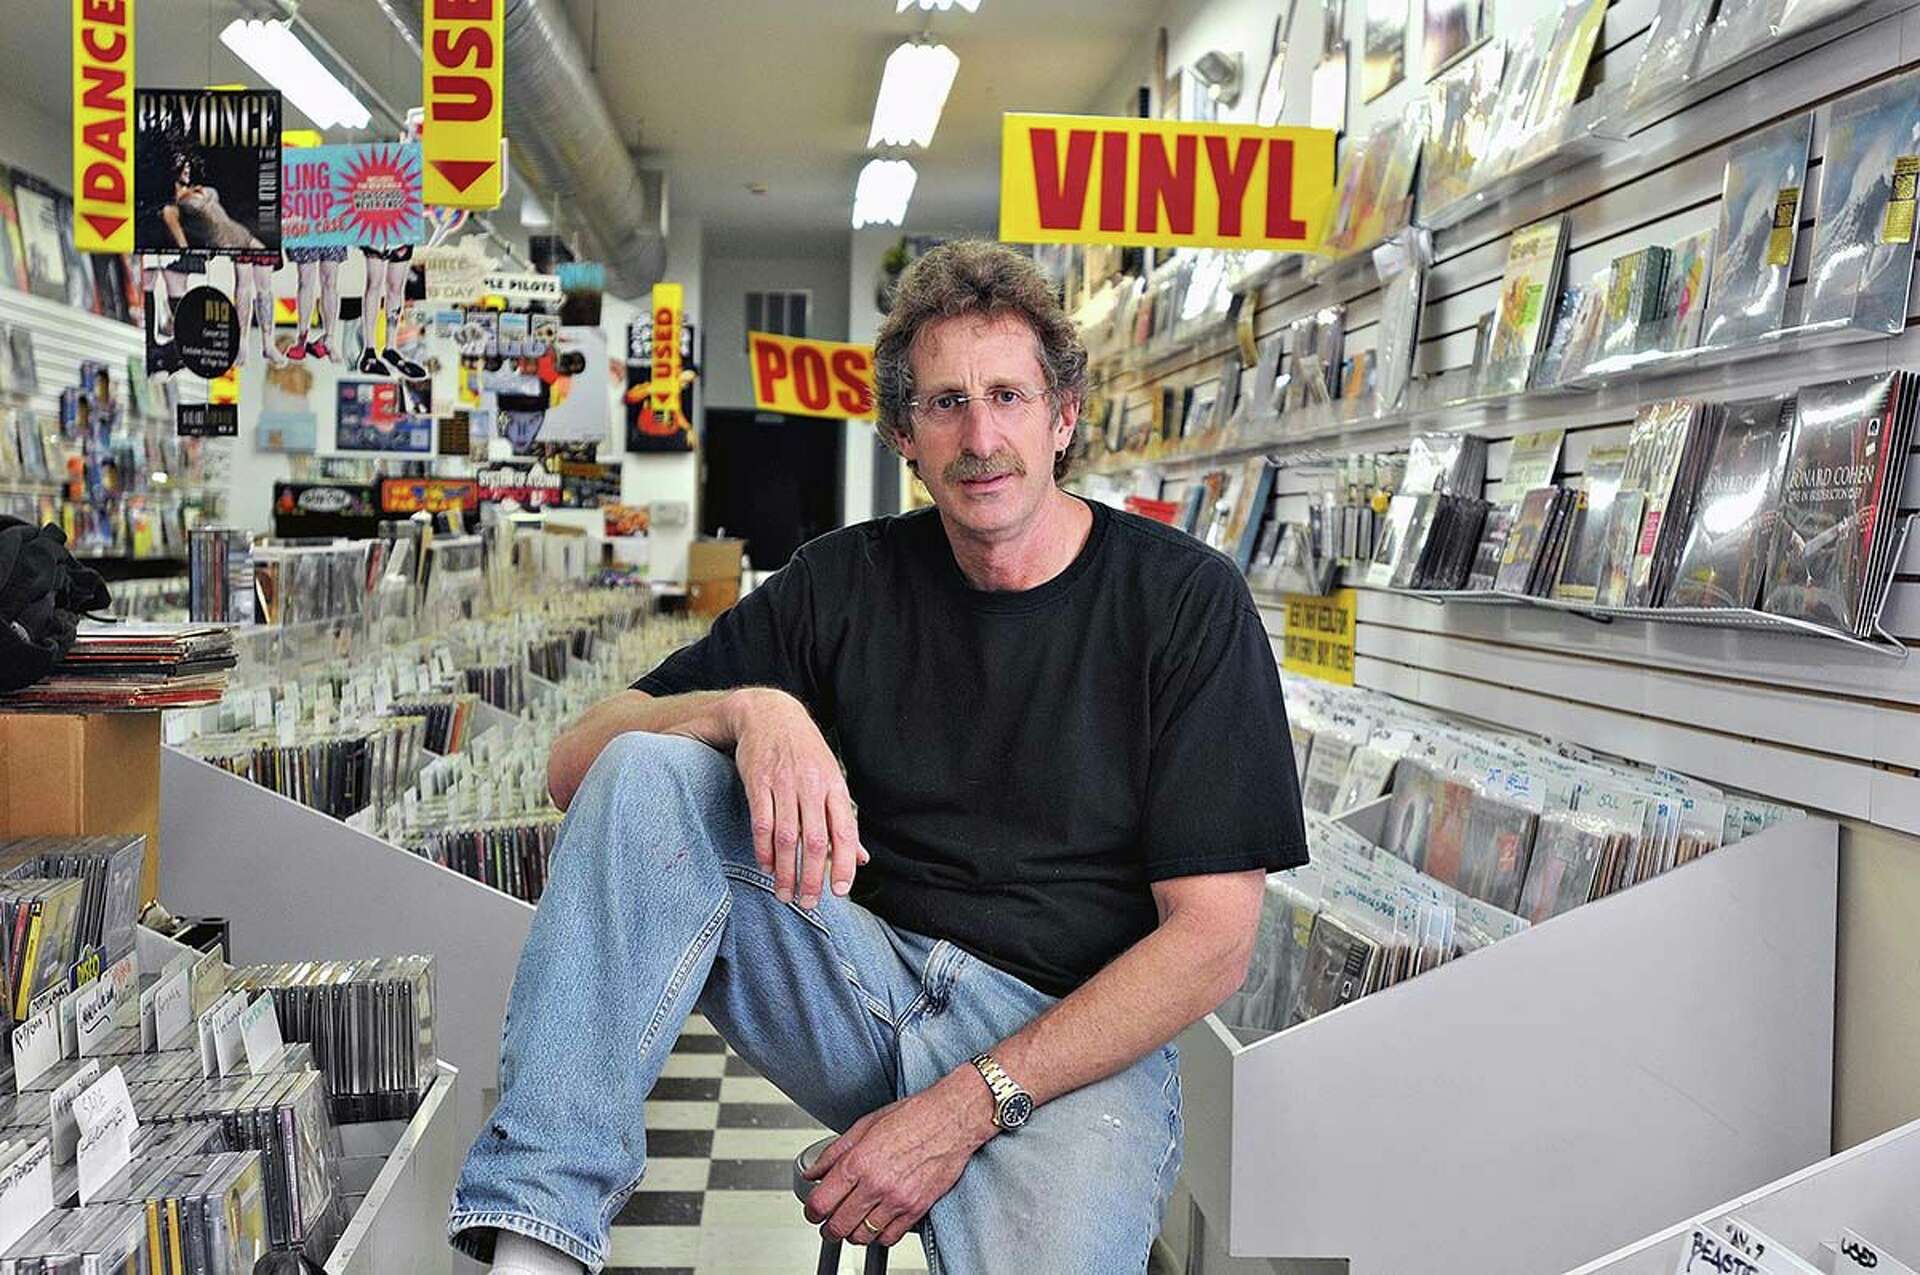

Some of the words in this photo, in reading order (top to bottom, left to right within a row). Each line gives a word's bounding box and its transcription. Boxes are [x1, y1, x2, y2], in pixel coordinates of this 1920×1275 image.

[82, 0, 126, 204] DANCE
[282, 191, 334, 219] SOUP
[1029, 128, 1306, 239] VINYL
[509, 279, 556, 293] PILOTS
[655, 308, 673, 379] USED
[755, 338, 875, 416] POS
